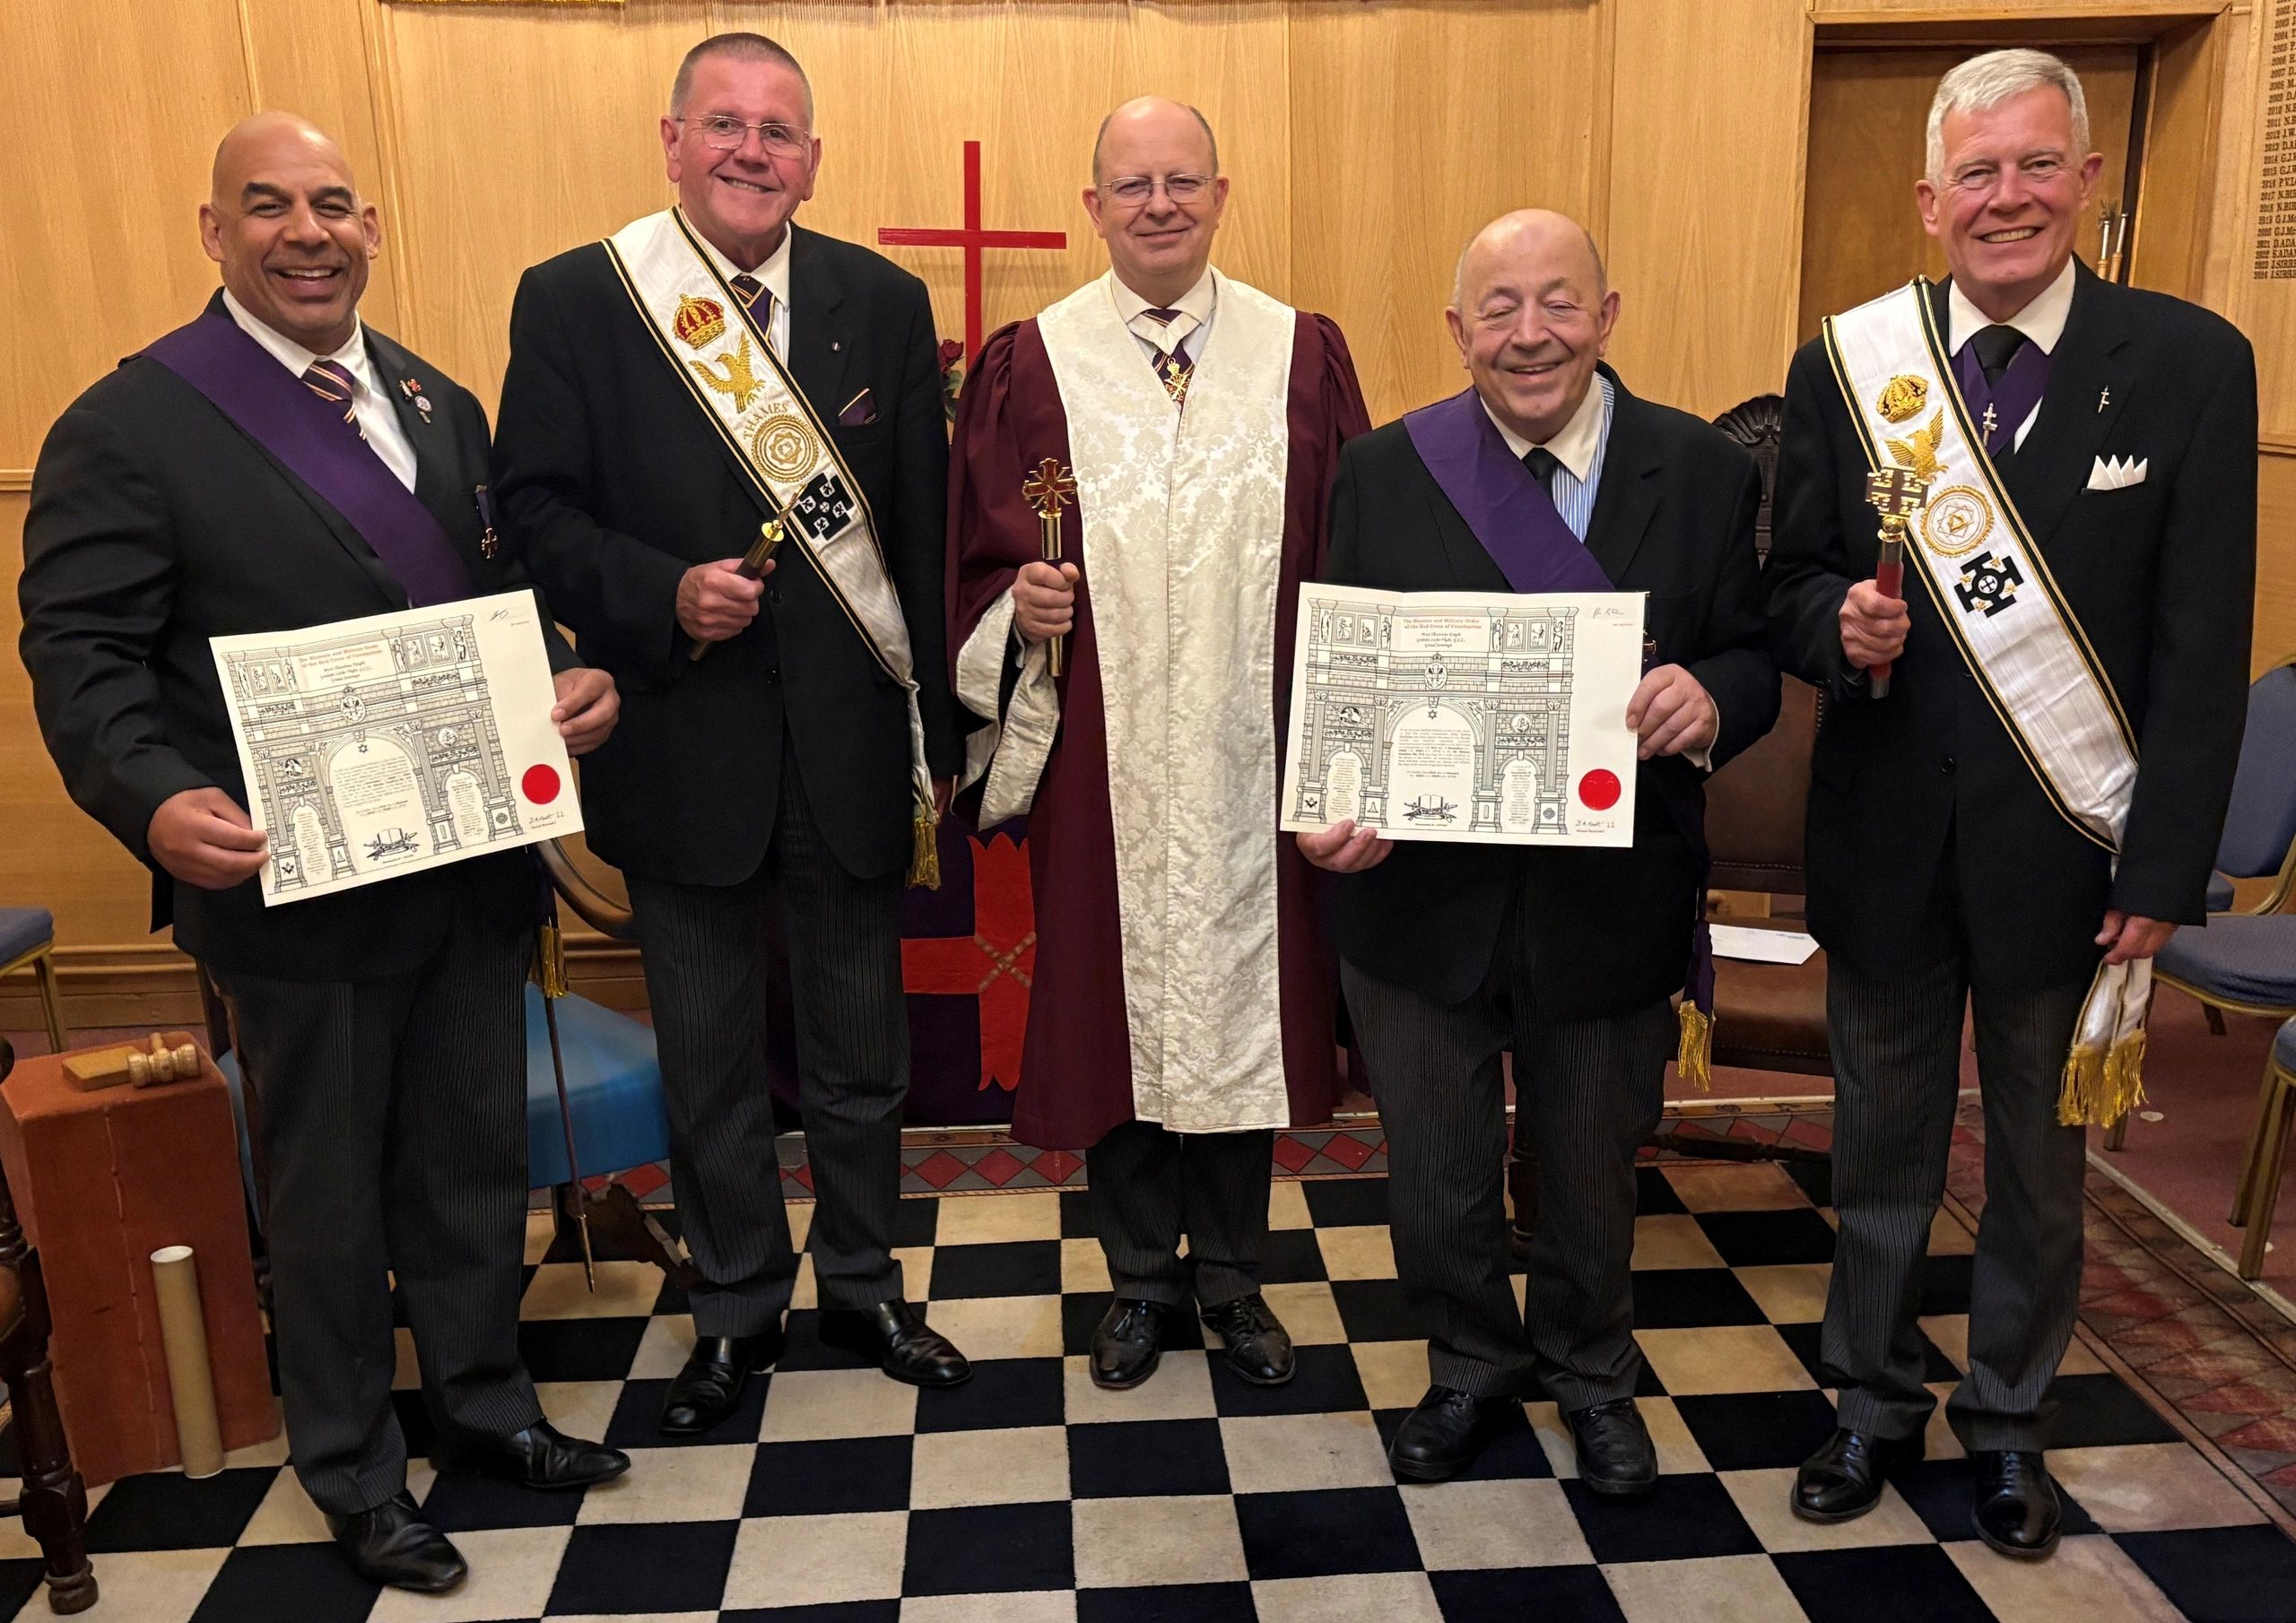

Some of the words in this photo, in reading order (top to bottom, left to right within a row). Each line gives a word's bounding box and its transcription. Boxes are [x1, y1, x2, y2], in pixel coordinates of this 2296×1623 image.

[2267, 106, 2283, 116] 2010
[2266, 118, 2281, 128] 2011
[2266, 130, 2280, 140] 2012
[2260, 191, 2275, 202] 2017
[744, 401, 789, 440] THAMES
